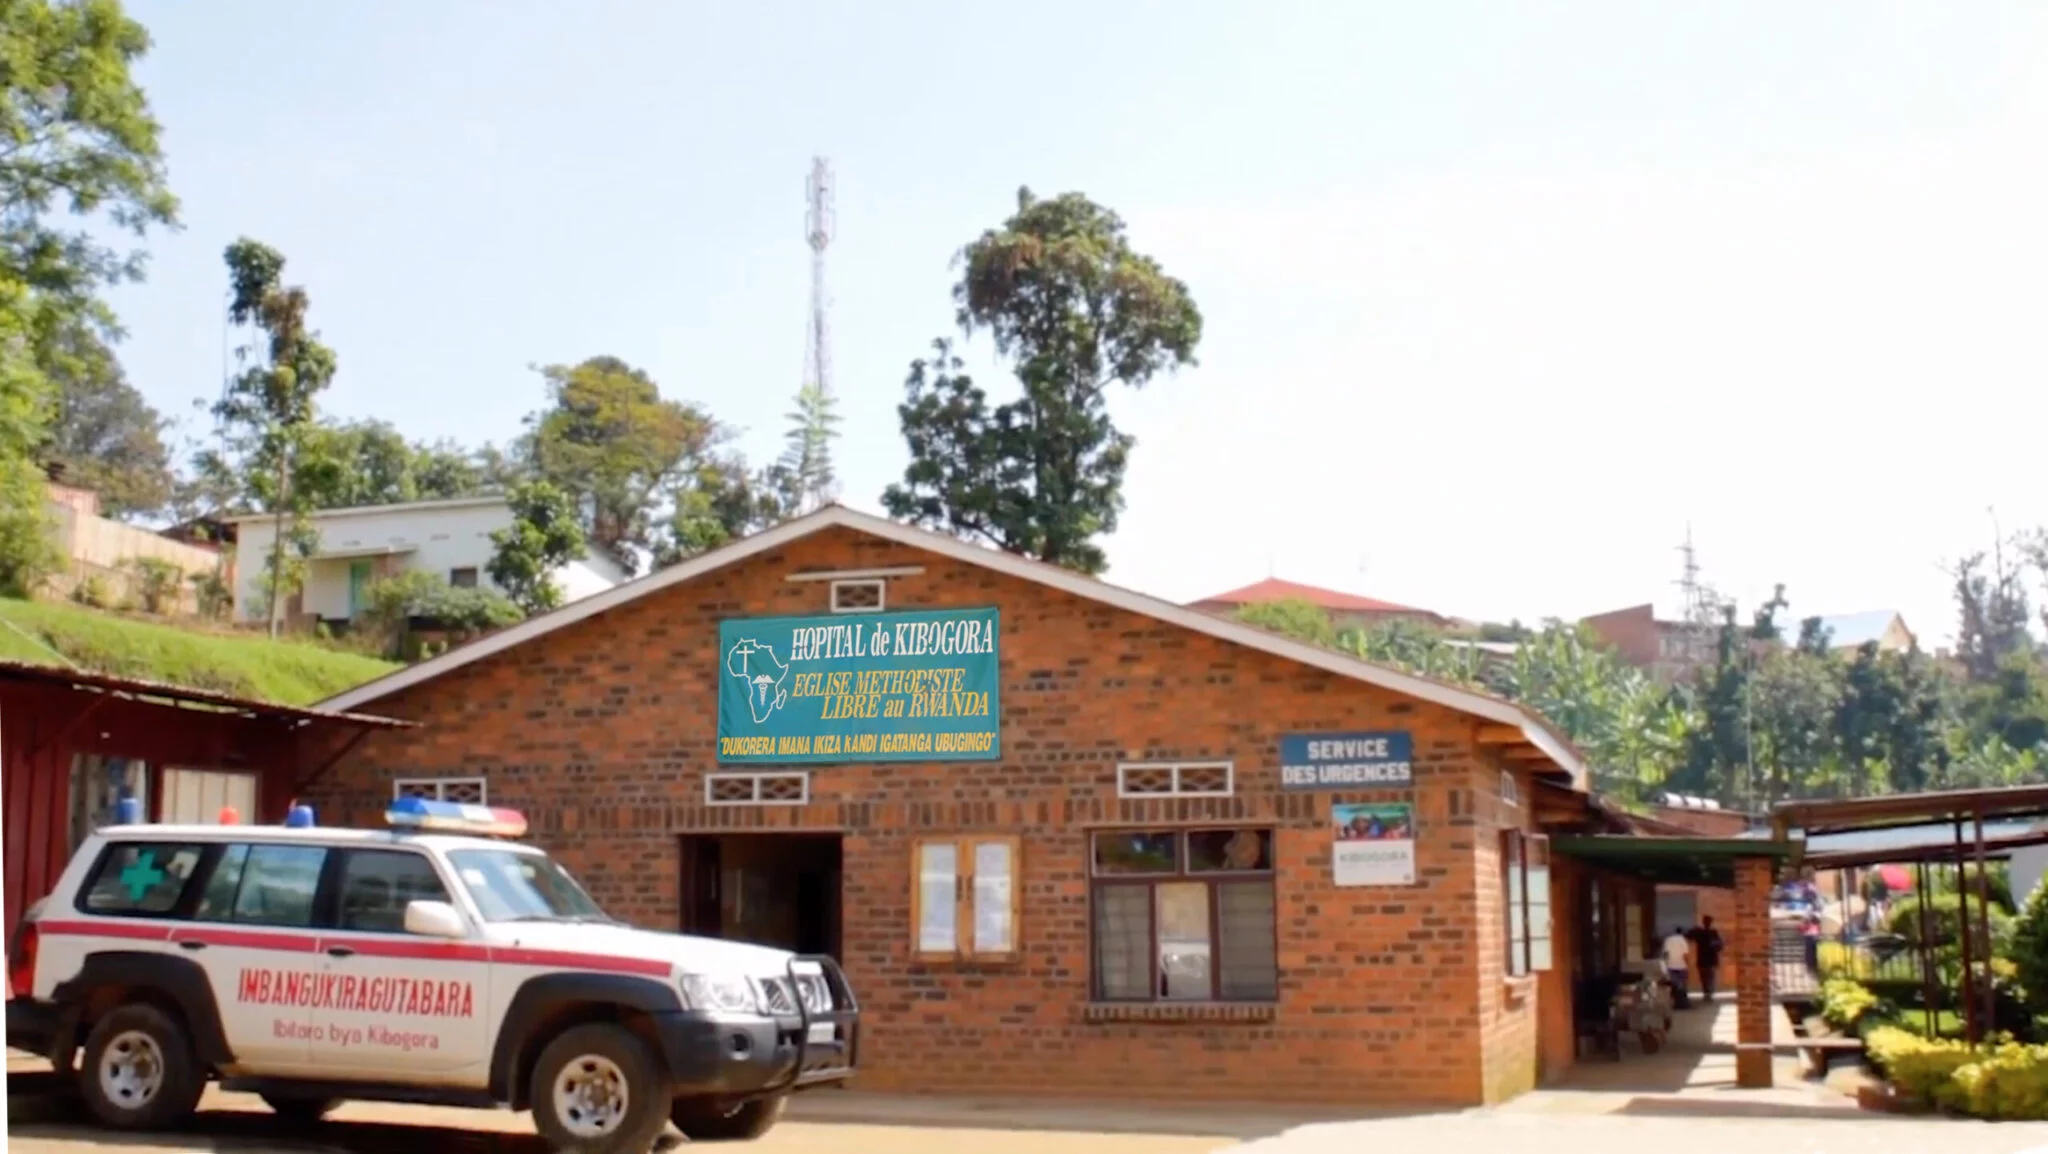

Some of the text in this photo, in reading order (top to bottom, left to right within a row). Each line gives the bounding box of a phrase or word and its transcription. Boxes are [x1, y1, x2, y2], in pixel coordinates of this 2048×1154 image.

[790, 620, 993, 660] HOPITAL de KIBOGORA
[792, 668, 965, 697] EGLISE METHODISTE
[820, 692, 989, 719] LIBRE au RWANDA
[778, 736, 811, 755] IMANA
[813, 735, 841, 754] IKIZA
[843, 735, 877, 753] KANDI
[879, 734, 932, 753] IGATANGA
[1307, 738, 1389, 760] SERVICE
[1282, 761, 1411, 785] DES URGENCES
[237, 967, 473, 1018] IMBANGUKIRAGUTABARA
[368, 1025, 439, 1050] Kibogora
